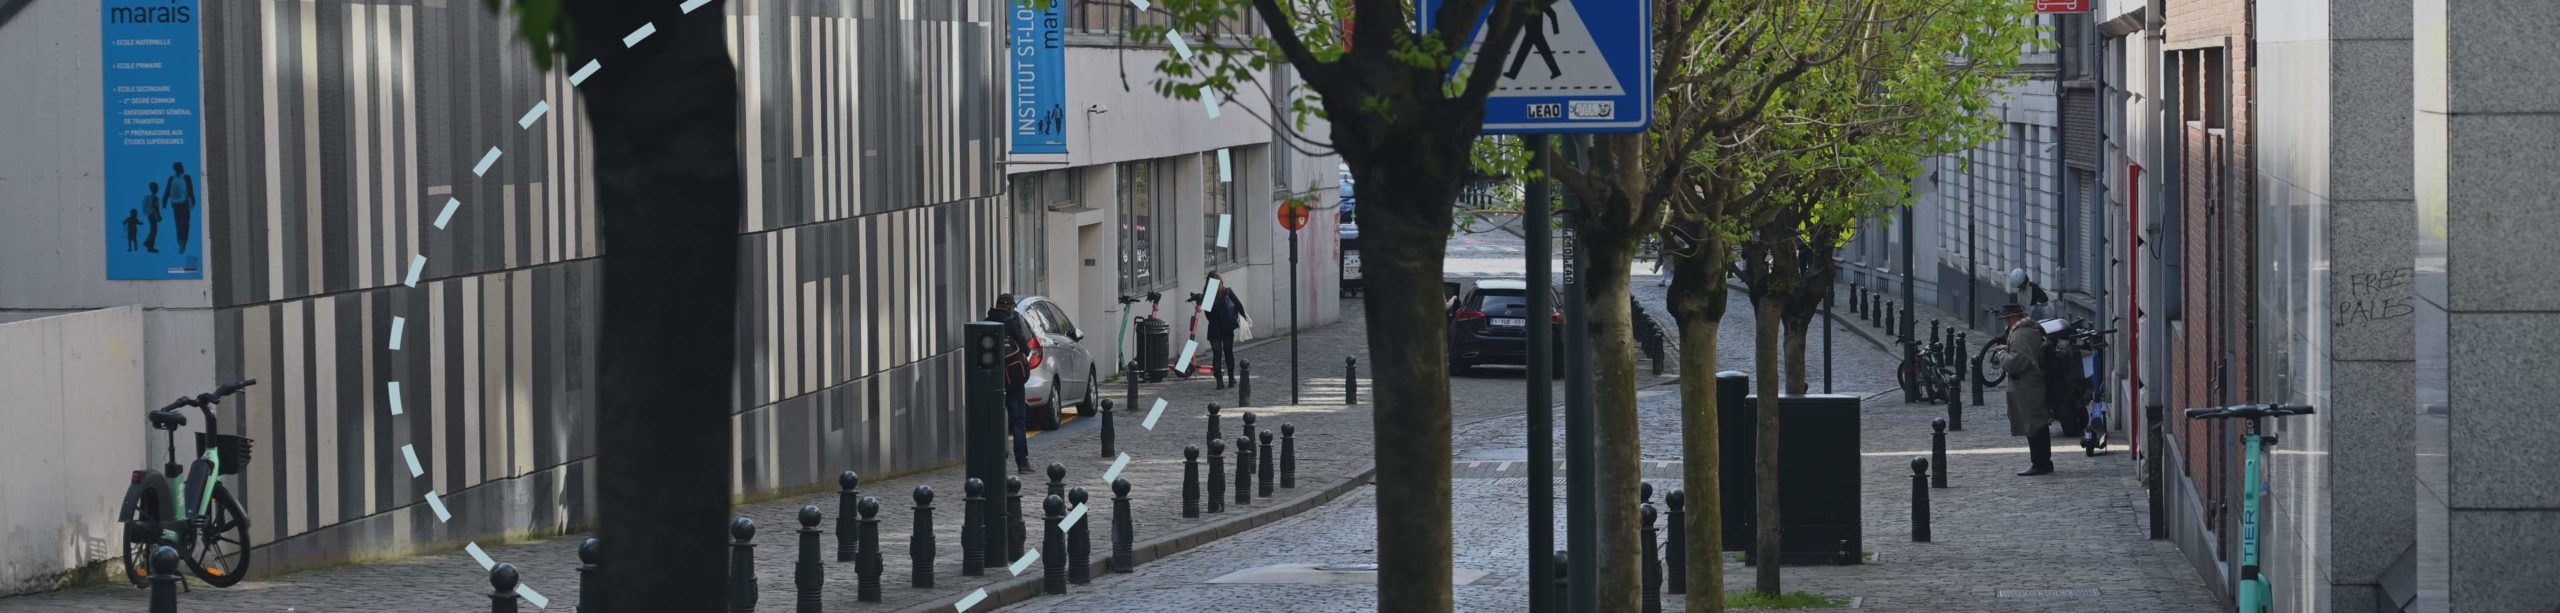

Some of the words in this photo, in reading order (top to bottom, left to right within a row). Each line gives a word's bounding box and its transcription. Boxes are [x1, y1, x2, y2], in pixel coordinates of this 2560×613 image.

[111, 0, 190, 24] marais
[1018, 61, 1035, 136] INSTITUT
[2351, 267, 2414, 299] FREE
[2244, 509, 2255, 563] TIER
